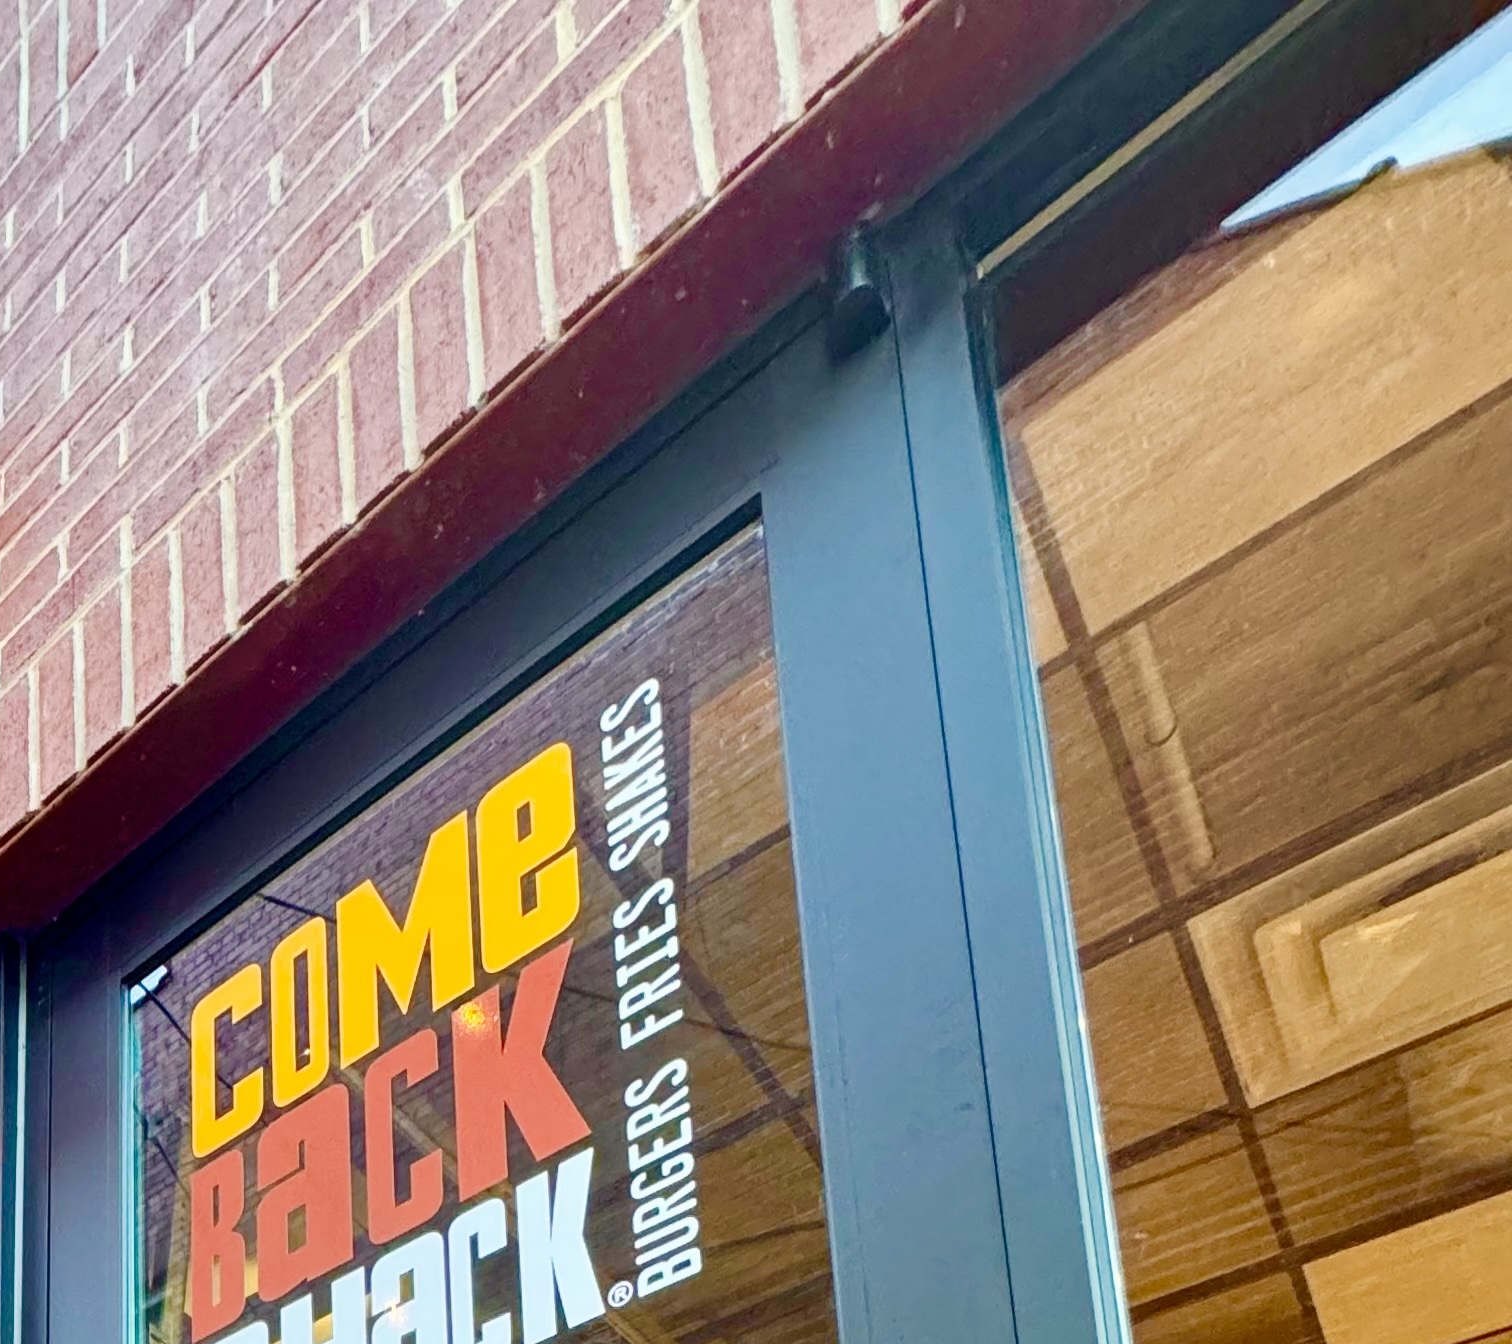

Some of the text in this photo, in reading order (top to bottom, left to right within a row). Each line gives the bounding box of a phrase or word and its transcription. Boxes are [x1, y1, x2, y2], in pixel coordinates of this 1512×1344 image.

[600, 678, 702, 1298] BURGERS FRIES SHAKES
